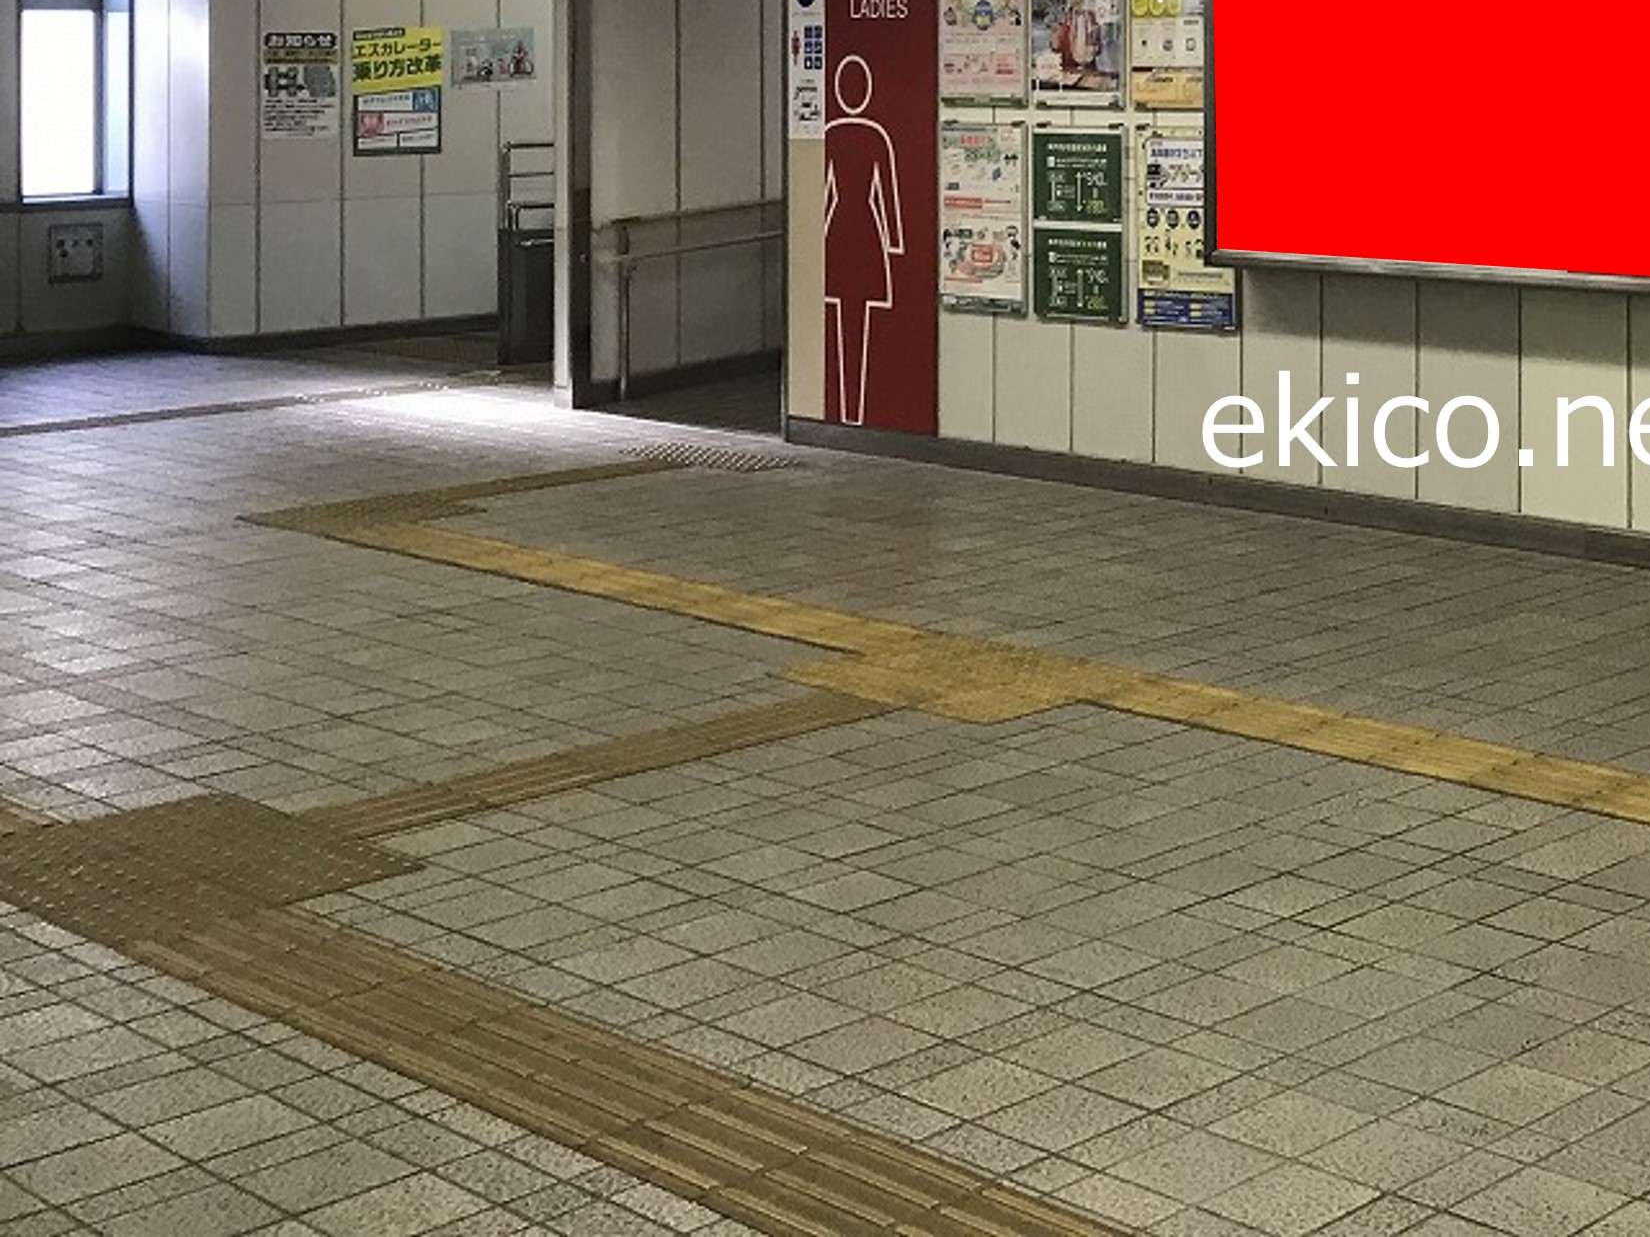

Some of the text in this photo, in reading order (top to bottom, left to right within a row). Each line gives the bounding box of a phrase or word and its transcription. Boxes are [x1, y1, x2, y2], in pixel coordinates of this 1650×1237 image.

[267, 33, 334, 48] お知らせ
[355, 38, 442, 58] エスカレーター
[353, 53, 442, 82] 乗り方改革
